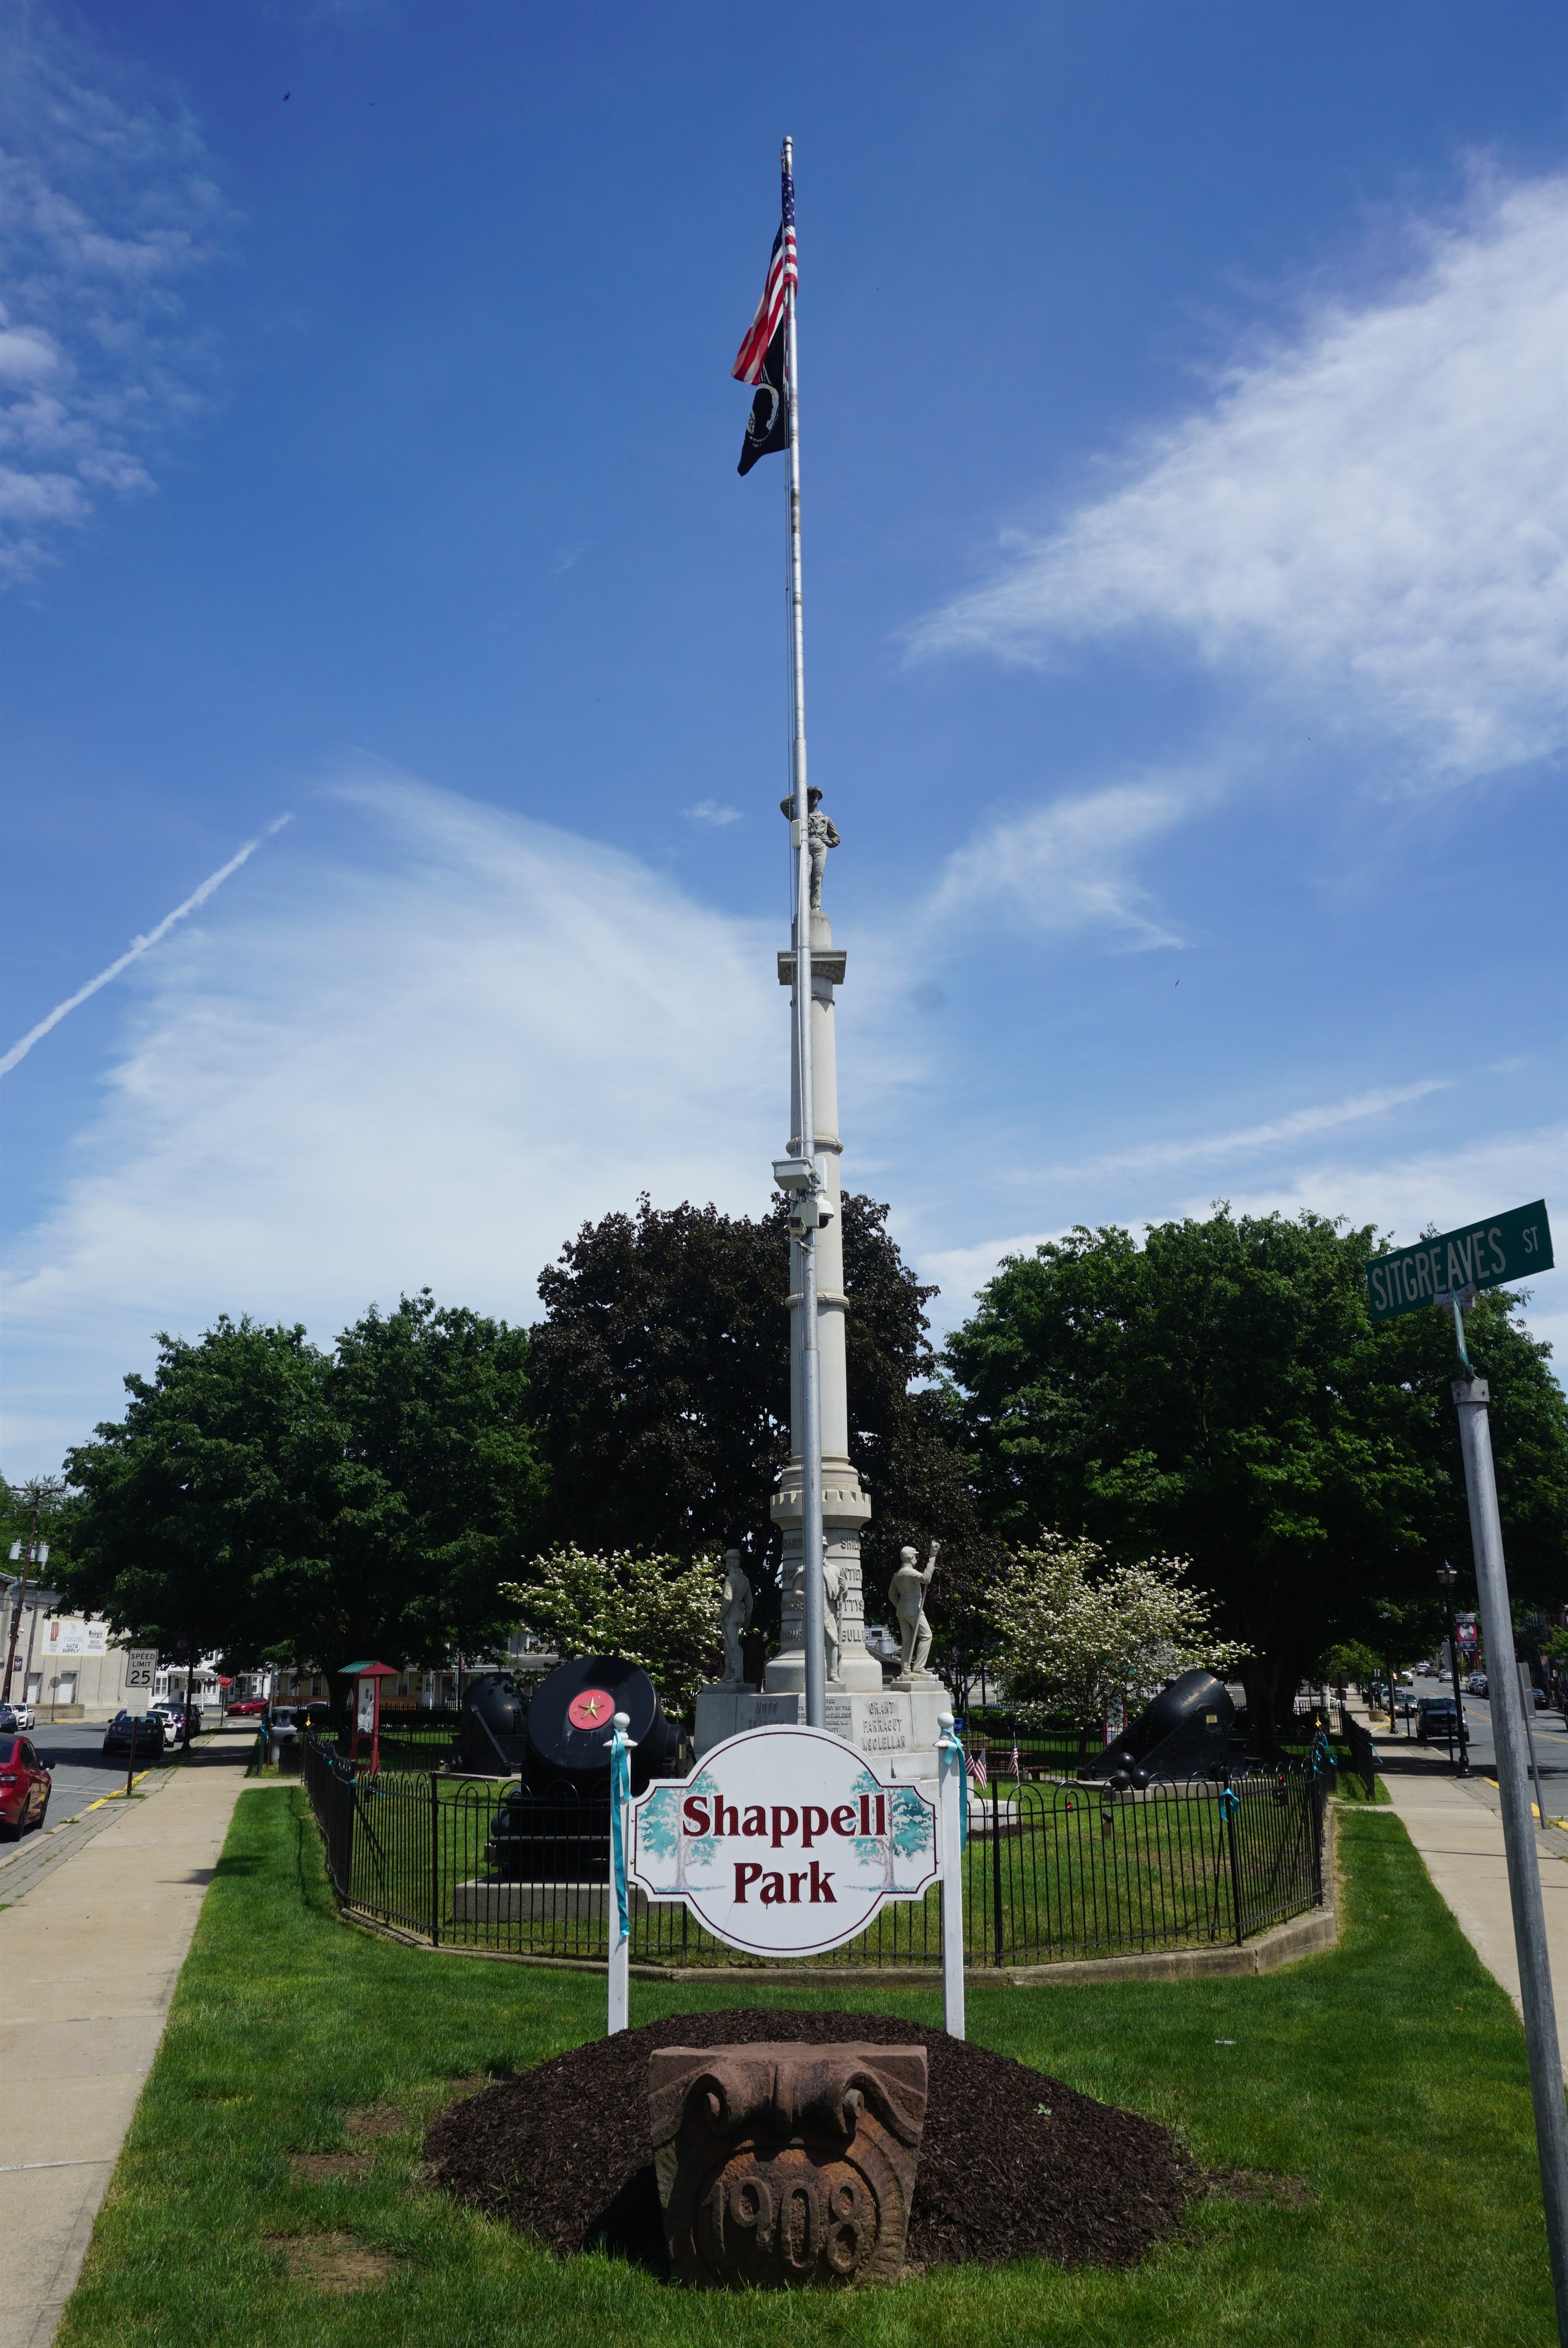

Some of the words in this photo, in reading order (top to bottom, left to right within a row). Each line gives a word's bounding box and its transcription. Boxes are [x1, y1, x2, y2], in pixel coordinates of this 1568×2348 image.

[1372, 1227, 1506, 1310] SITGREAVES
[1523, 1226, 1539, 1253] ST
[130, 1671, 150, 1684] 25
[863, 1718, 902, 1733] FARRAGUT
[869, 1701, 894, 1715] GRANT
[683, 1794, 888, 1848] Shappell
[734, 1861, 837, 1904] Park
[700, 2176, 864, 2274] 1908
